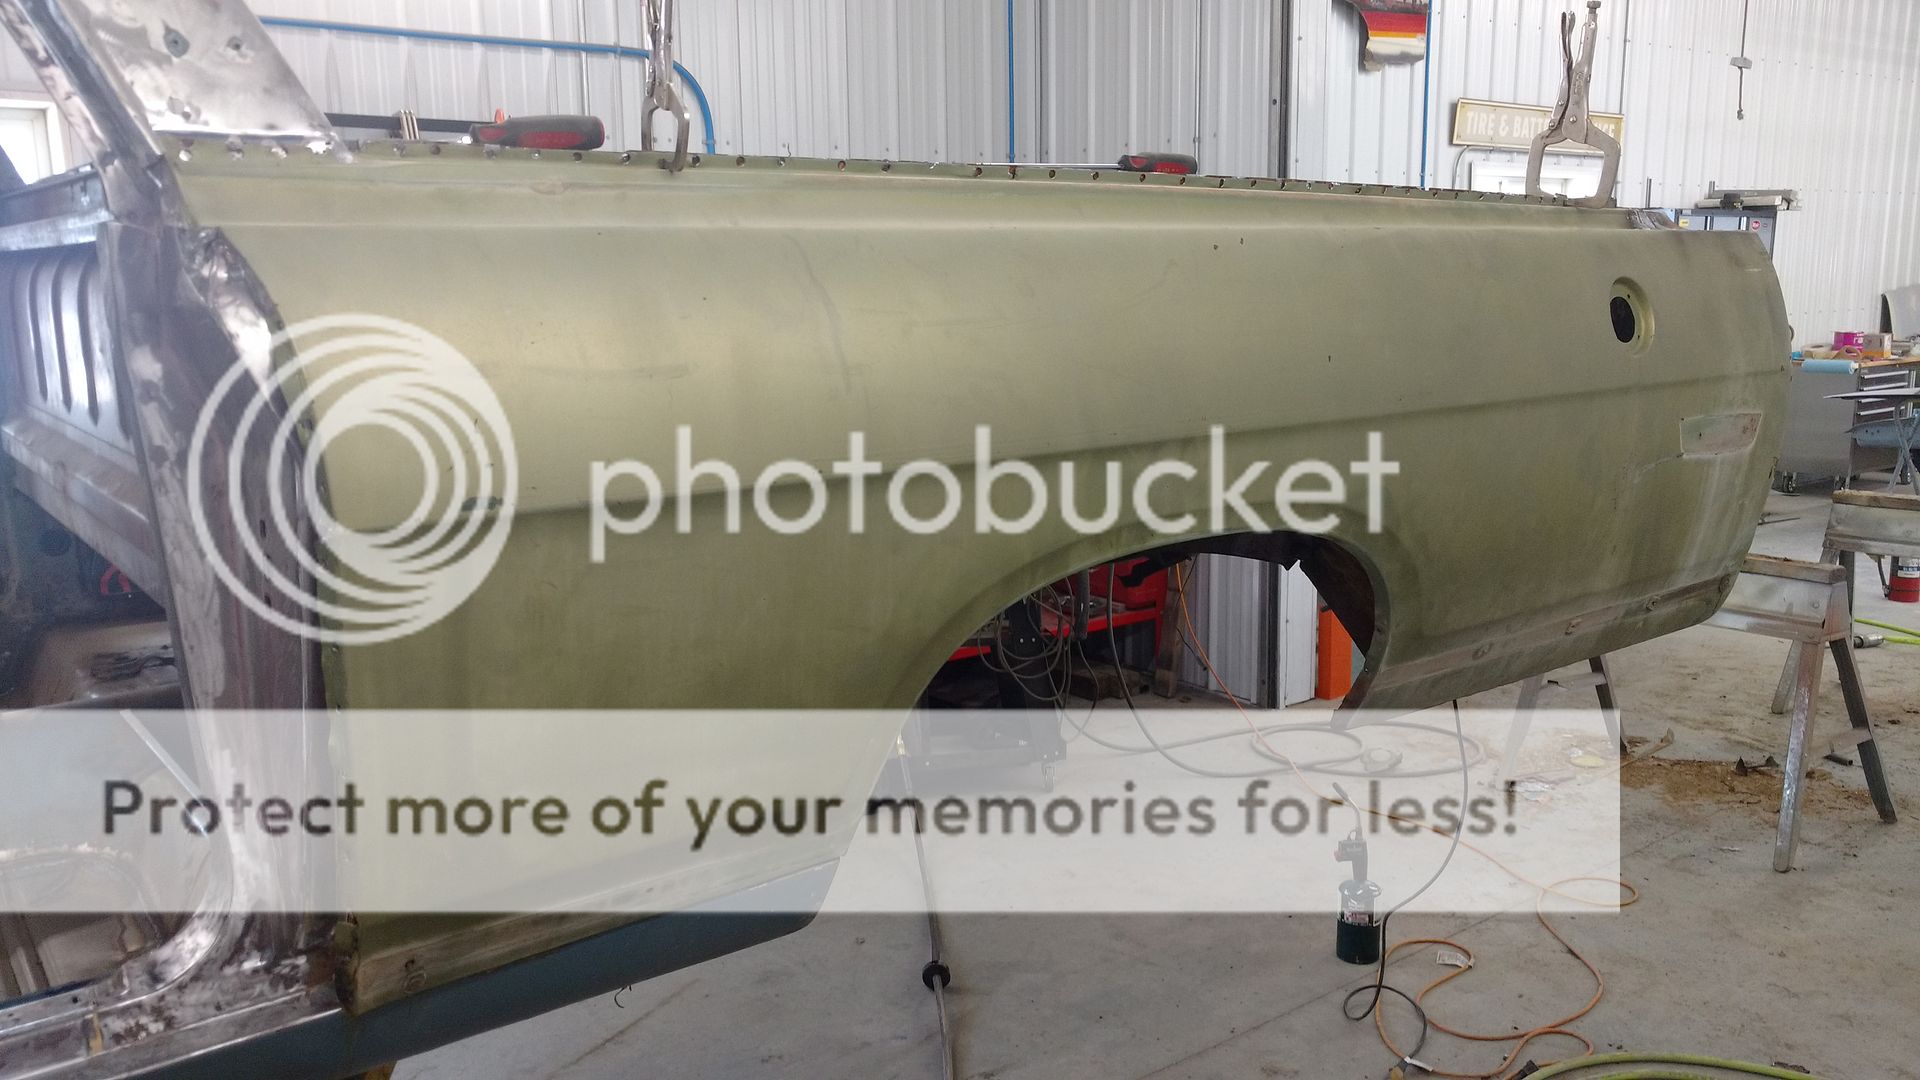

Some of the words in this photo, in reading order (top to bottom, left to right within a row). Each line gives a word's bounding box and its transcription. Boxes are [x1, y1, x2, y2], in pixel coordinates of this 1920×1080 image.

[1466, 111, 1496, 135] TIRE
[1499, 114, 1509, 137] &
[1513, 116, 1549, 138] BATT
